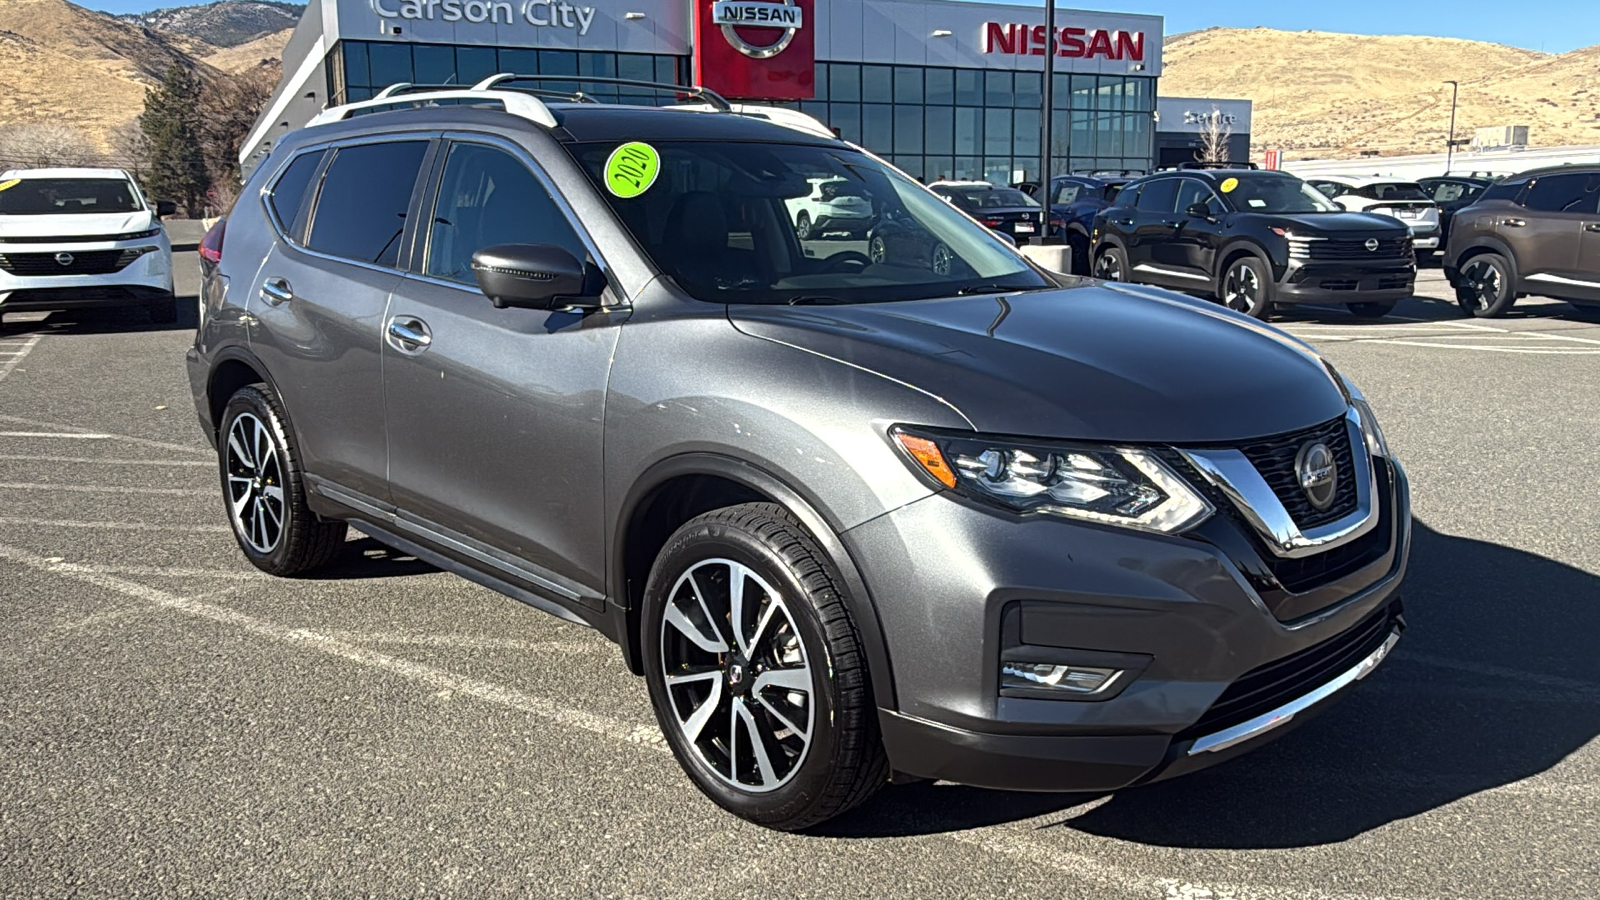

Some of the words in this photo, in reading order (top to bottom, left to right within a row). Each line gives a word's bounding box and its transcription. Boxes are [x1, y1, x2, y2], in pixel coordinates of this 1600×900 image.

[373, 0, 513, 24] Carson
[524, 0, 596, 35] City
[724, 6, 795, 23] NISSAN
[985, 22, 1145, 61] NISSAN
[1185, 110, 1237, 124] Serice
[614, 147, 650, 188] 2020
